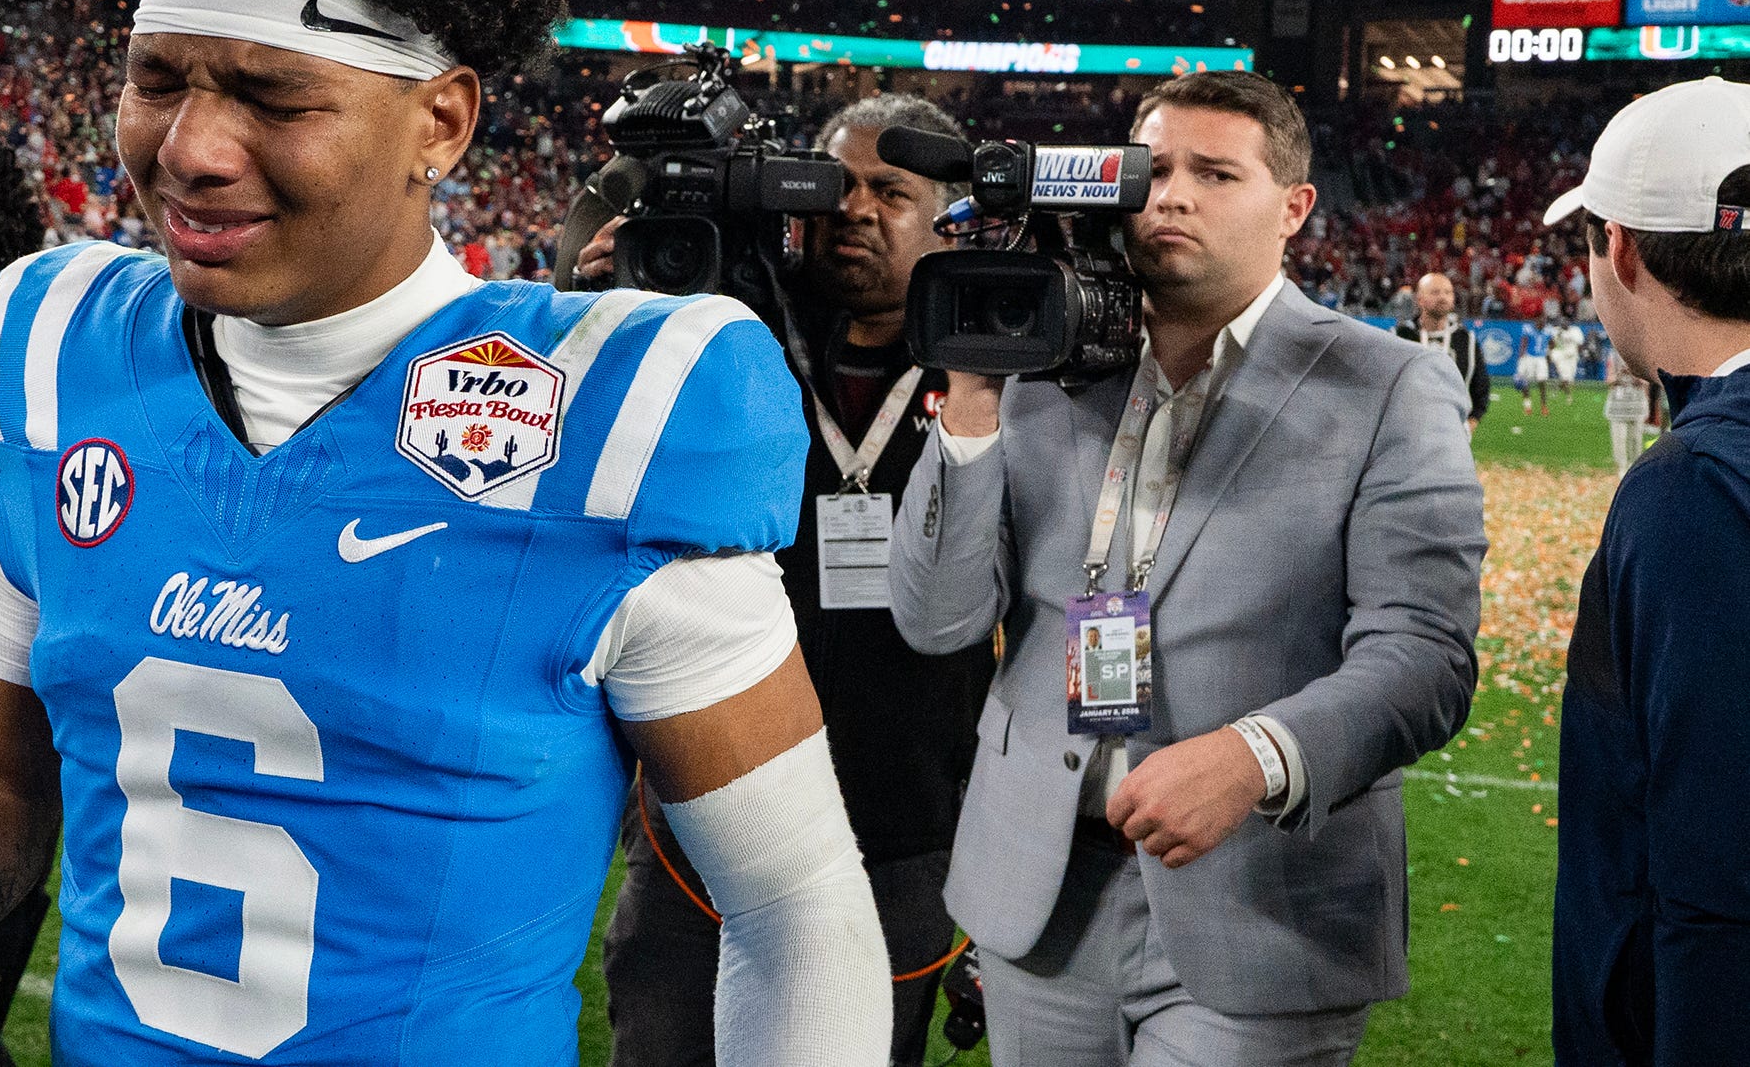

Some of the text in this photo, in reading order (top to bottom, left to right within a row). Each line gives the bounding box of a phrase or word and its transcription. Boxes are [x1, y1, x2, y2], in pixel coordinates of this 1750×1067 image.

[923, 40, 1082, 74] CHAMPIONS
[1488, 28, 1584, 63] 00:00
[982, 172, 1006, 183] JVC
[1036, 153, 1103, 181] WLOX
[1033, 185, 1119, 198] NEWS NOW
[447, 369, 529, 398] Vrbo
[408, 398, 554, 432] Fiesta Bowl
[60, 446, 127, 539] SEC
[149, 571, 291, 655] Ole Miss
[109, 656, 324, 1060] 6
